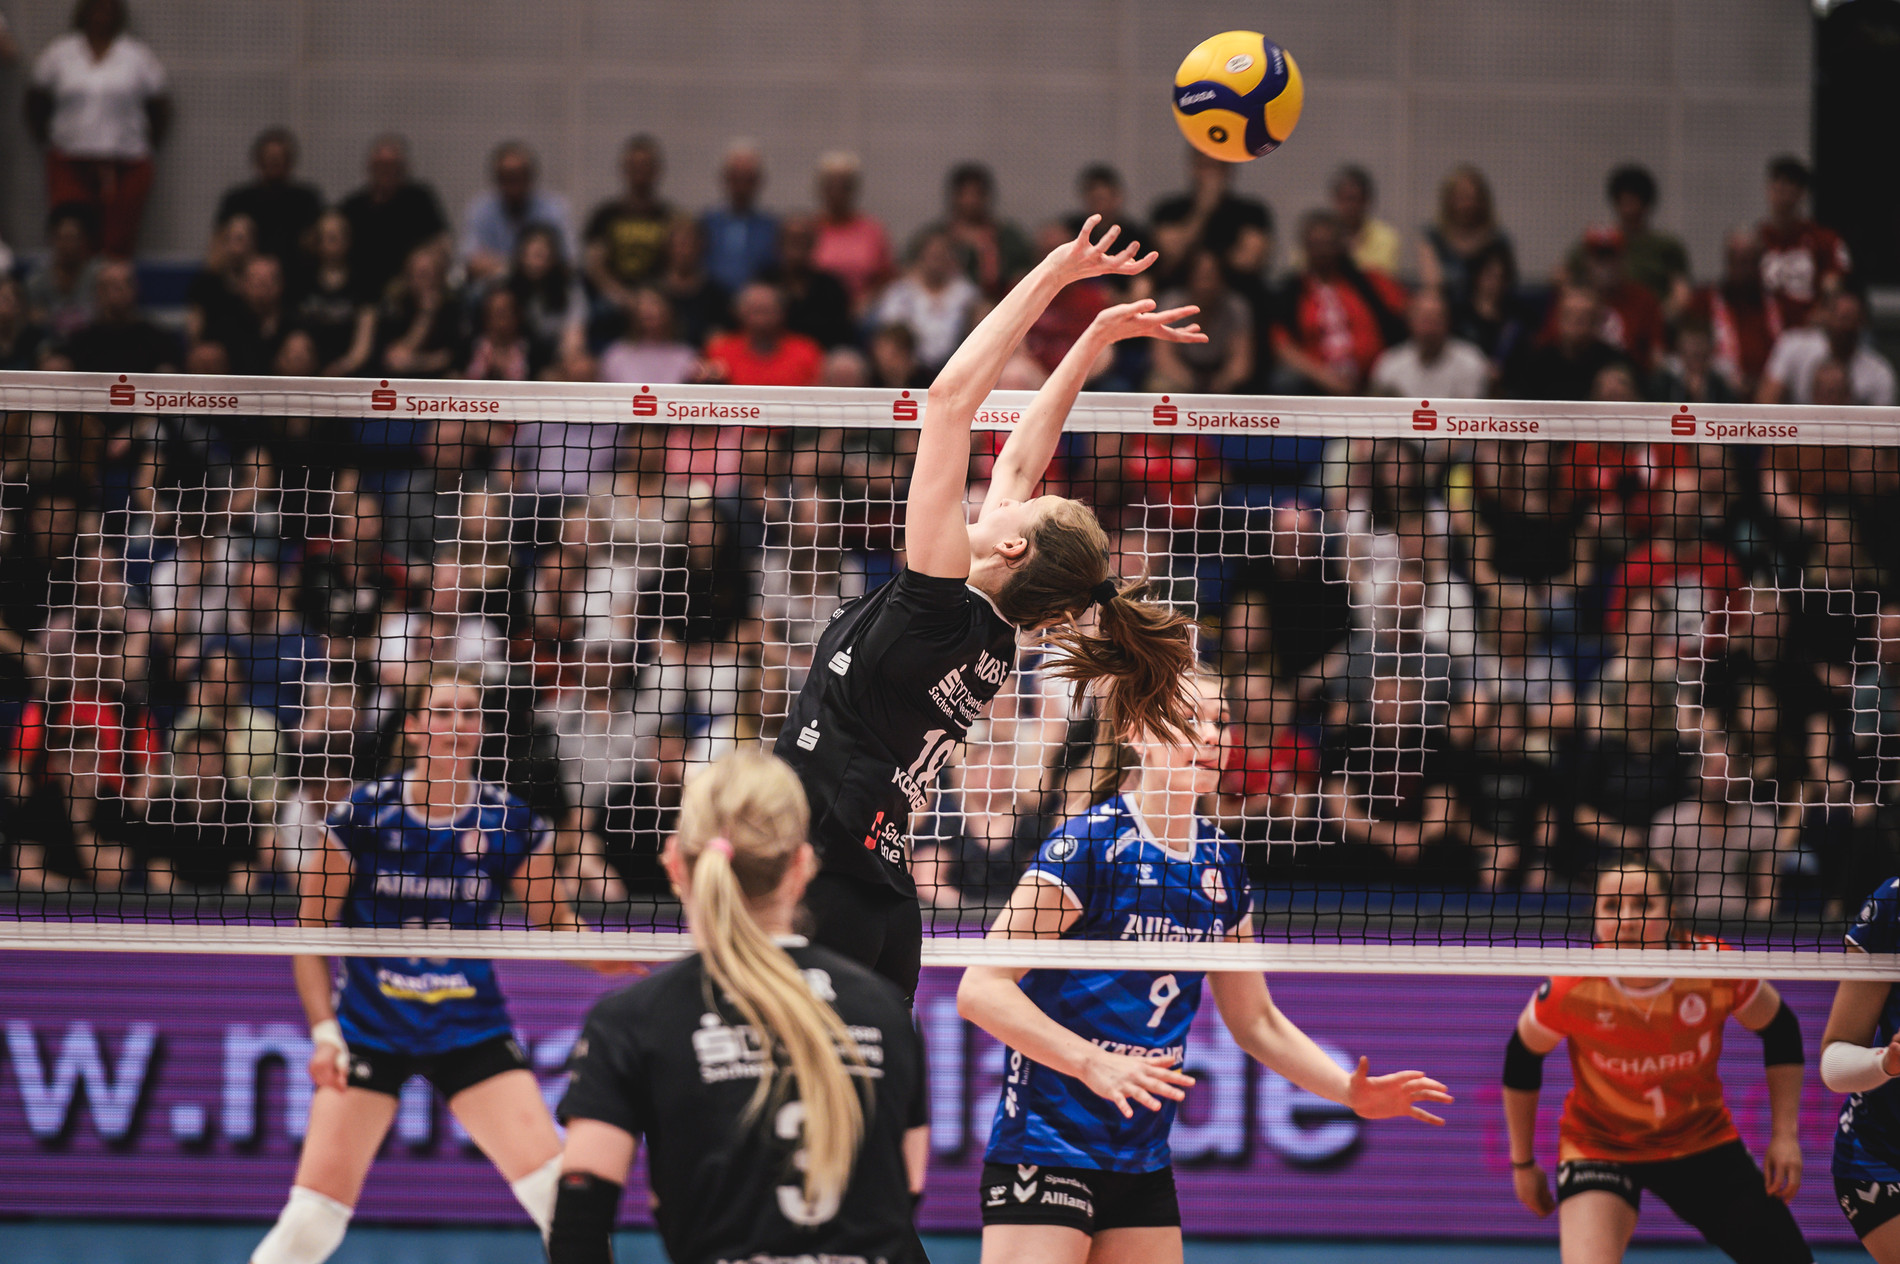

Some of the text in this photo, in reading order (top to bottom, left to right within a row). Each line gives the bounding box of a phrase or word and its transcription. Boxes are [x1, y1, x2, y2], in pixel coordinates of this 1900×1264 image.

[144, 391, 239, 410] Sparkasse
[405, 395, 500, 415] Sparkasse
[666, 400, 761, 420] Sparkasse
[1186, 410, 1281, 430] Sparkasse
[1446, 415, 1540, 435] Sparkasse
[1704, 420, 1799, 440] Sparkasse
[928, 685, 955, 719] Sachsen
[906, 729, 956, 791] 18
[1120, 913, 1203, 942] Allianz
[1146, 973, 1181, 1028] 9
[1642, 1087, 1667, 1119] 1
[774, 1101, 842, 1227] 3
[1040, 1190, 1088, 1211] Allianz
